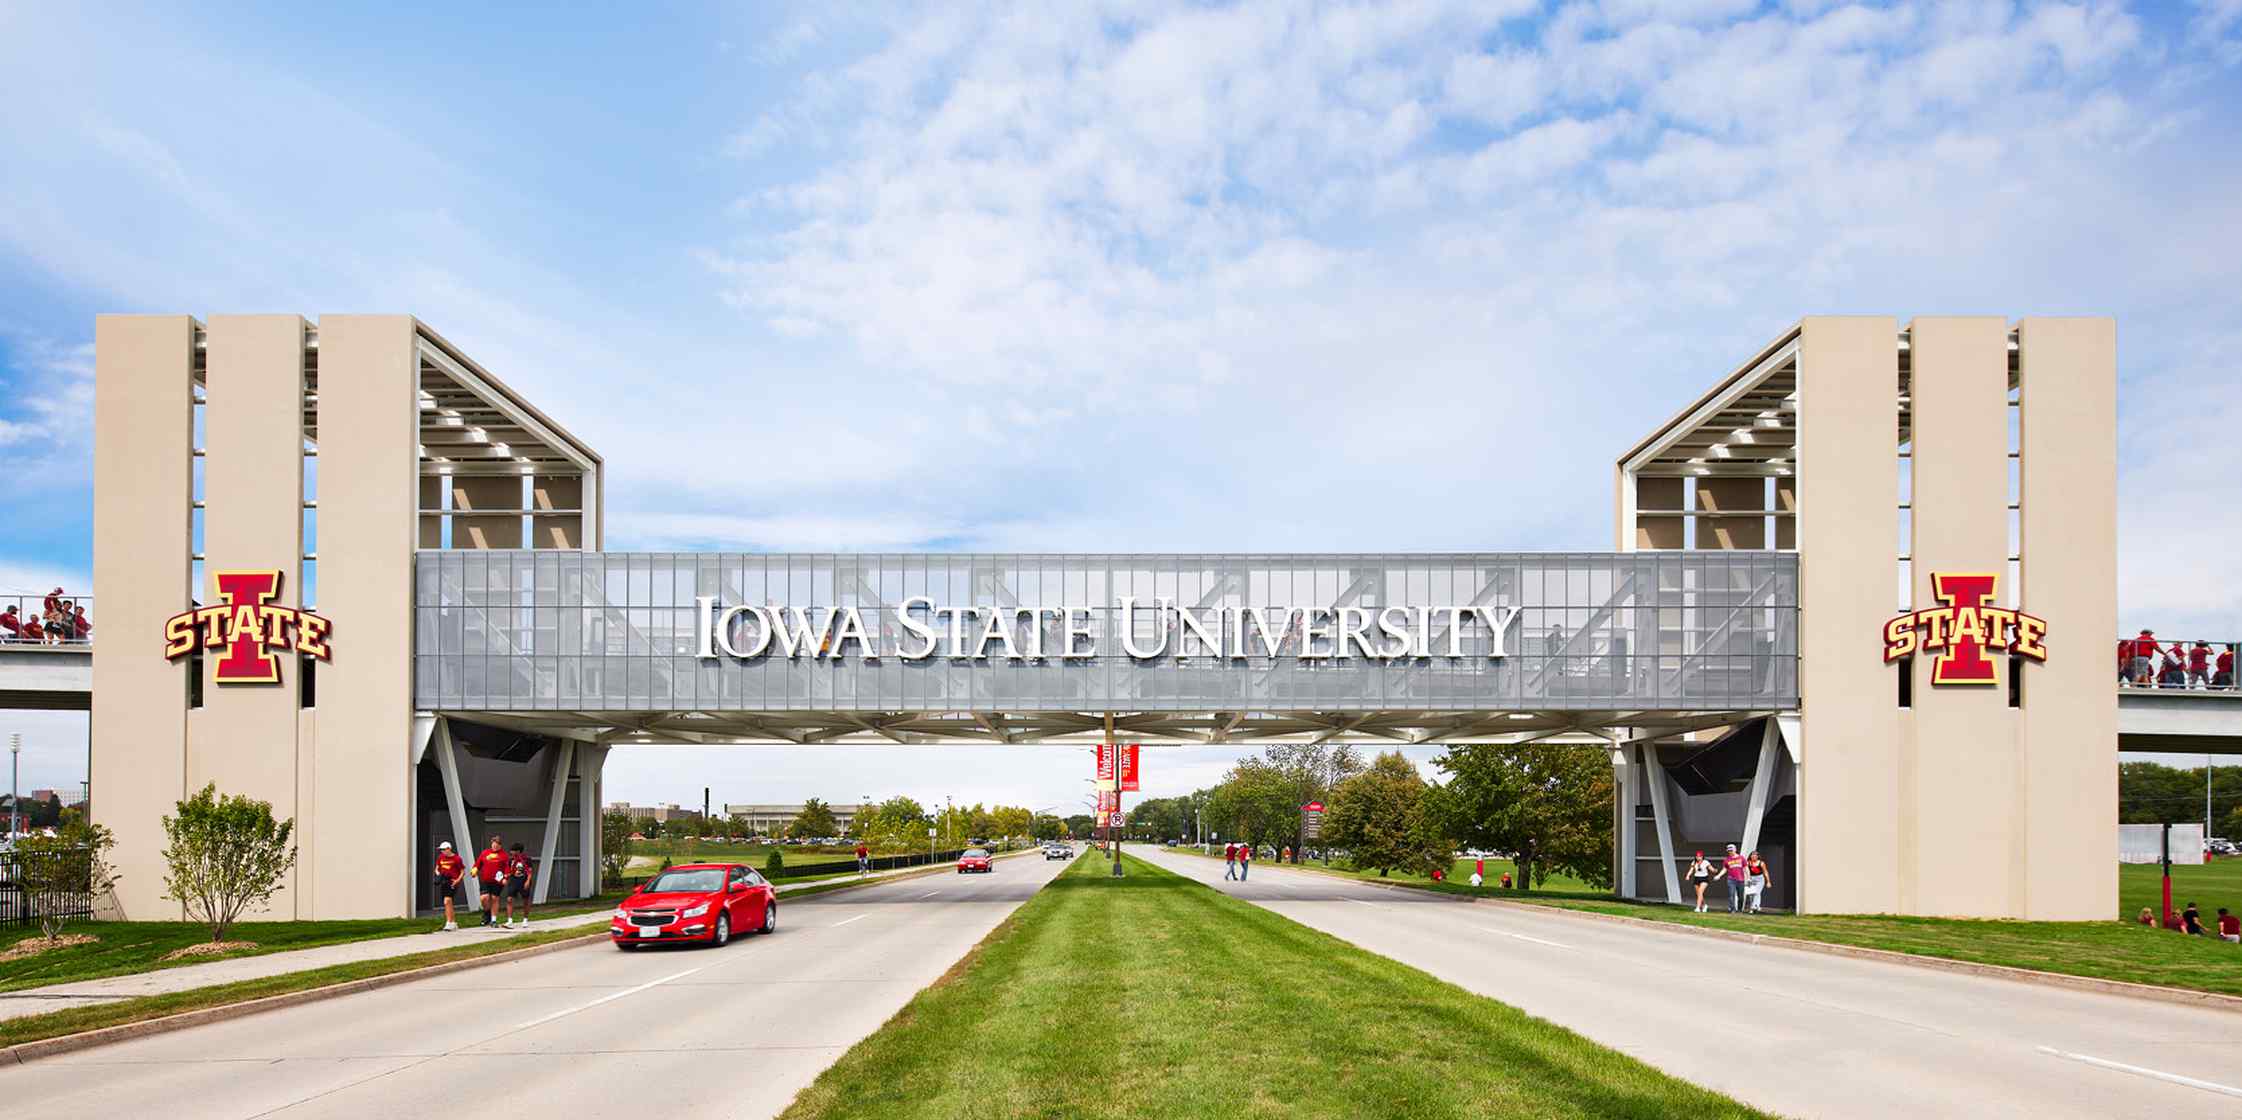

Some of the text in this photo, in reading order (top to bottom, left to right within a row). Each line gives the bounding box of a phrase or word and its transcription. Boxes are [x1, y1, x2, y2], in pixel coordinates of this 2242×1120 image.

[165, 604, 331, 660] STATE
[696, 596, 1522, 660] IOWA STATE UNIVERSITY
[1884, 606, 2047, 662] STATE
[1099, 744, 1112, 779] Welcom
